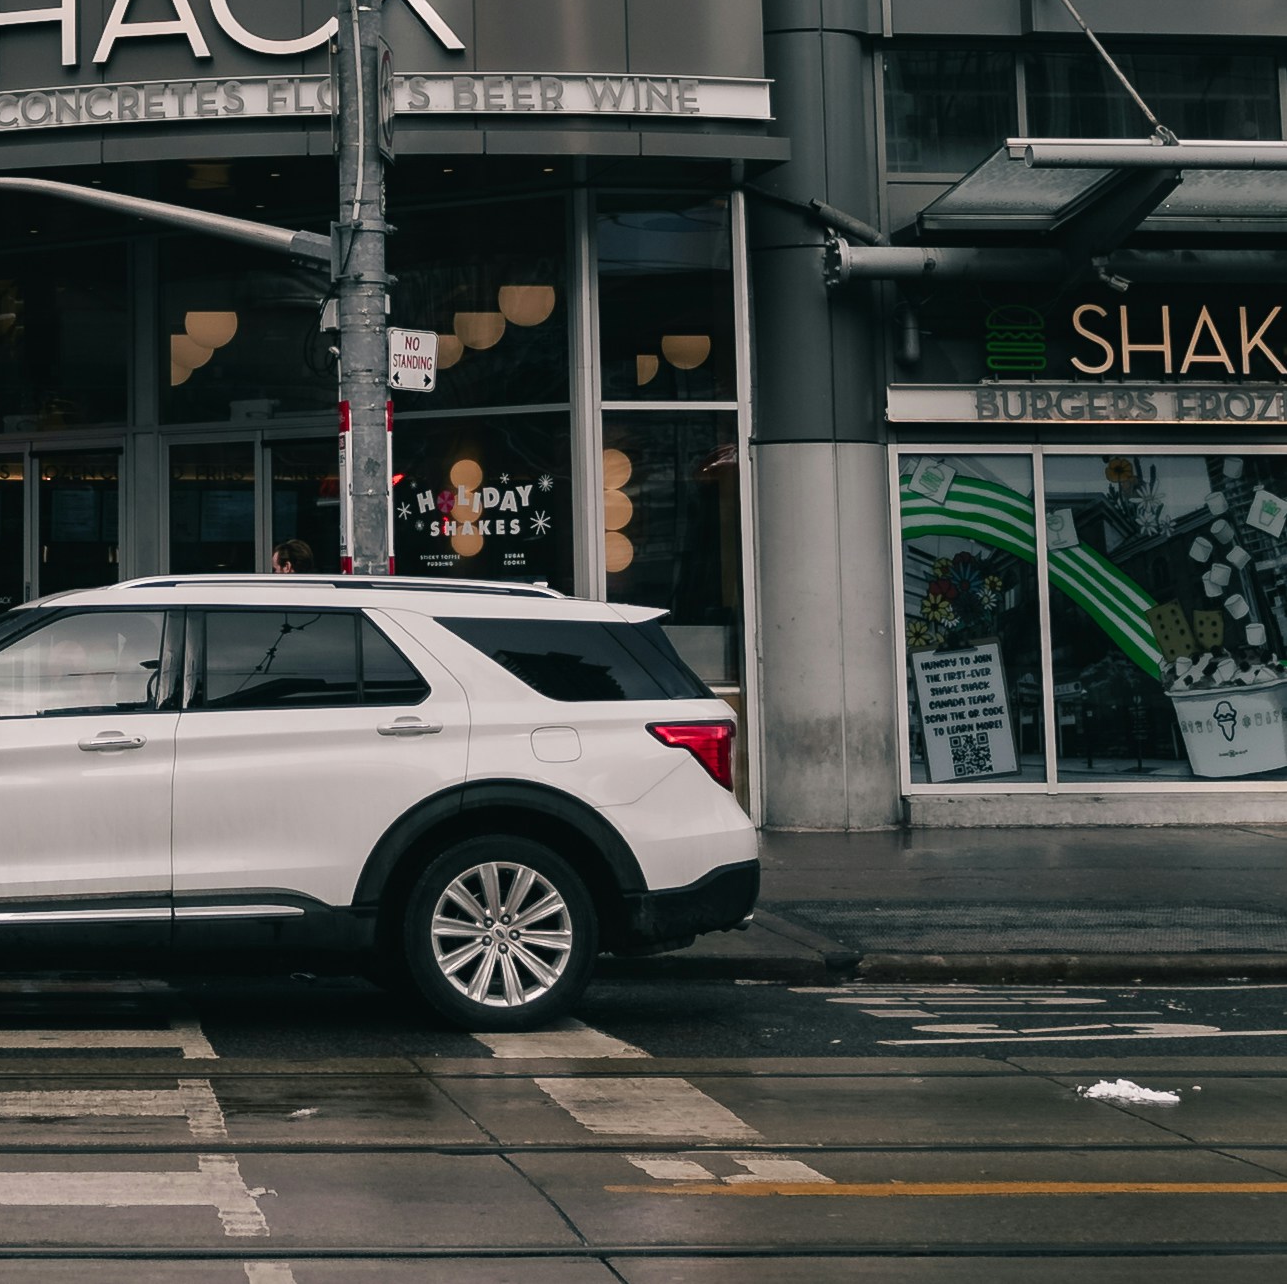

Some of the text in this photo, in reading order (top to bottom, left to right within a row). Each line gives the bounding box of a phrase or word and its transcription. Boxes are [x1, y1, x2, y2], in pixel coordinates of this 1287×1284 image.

[453, 75, 565, 110] BEER
[586, 77, 701, 113] WINE
[405, 336, 420, 351] NO
[1070, 304, 1287, 375] SHAK
[392, 353, 433, 371] STANDING
[975, 388, 1287, 421] BURGERS FROZ
[430, 518, 521, 536] SHAKES
[921, 654, 992, 670] HUNGRY TO JOIN
[925, 668, 991, 683] THE FIRST-EVER
[930, 681, 990, 696] SHAKE SHACK
[929, 693, 995, 710] CANADA TEAM?
[924, 714, 947, 724] SCAN
[950, 711, 966, 721] THE
[982, 706, 1004, 716] CODE
[933, 719, 1003, 736] TO LEARN MORE!
